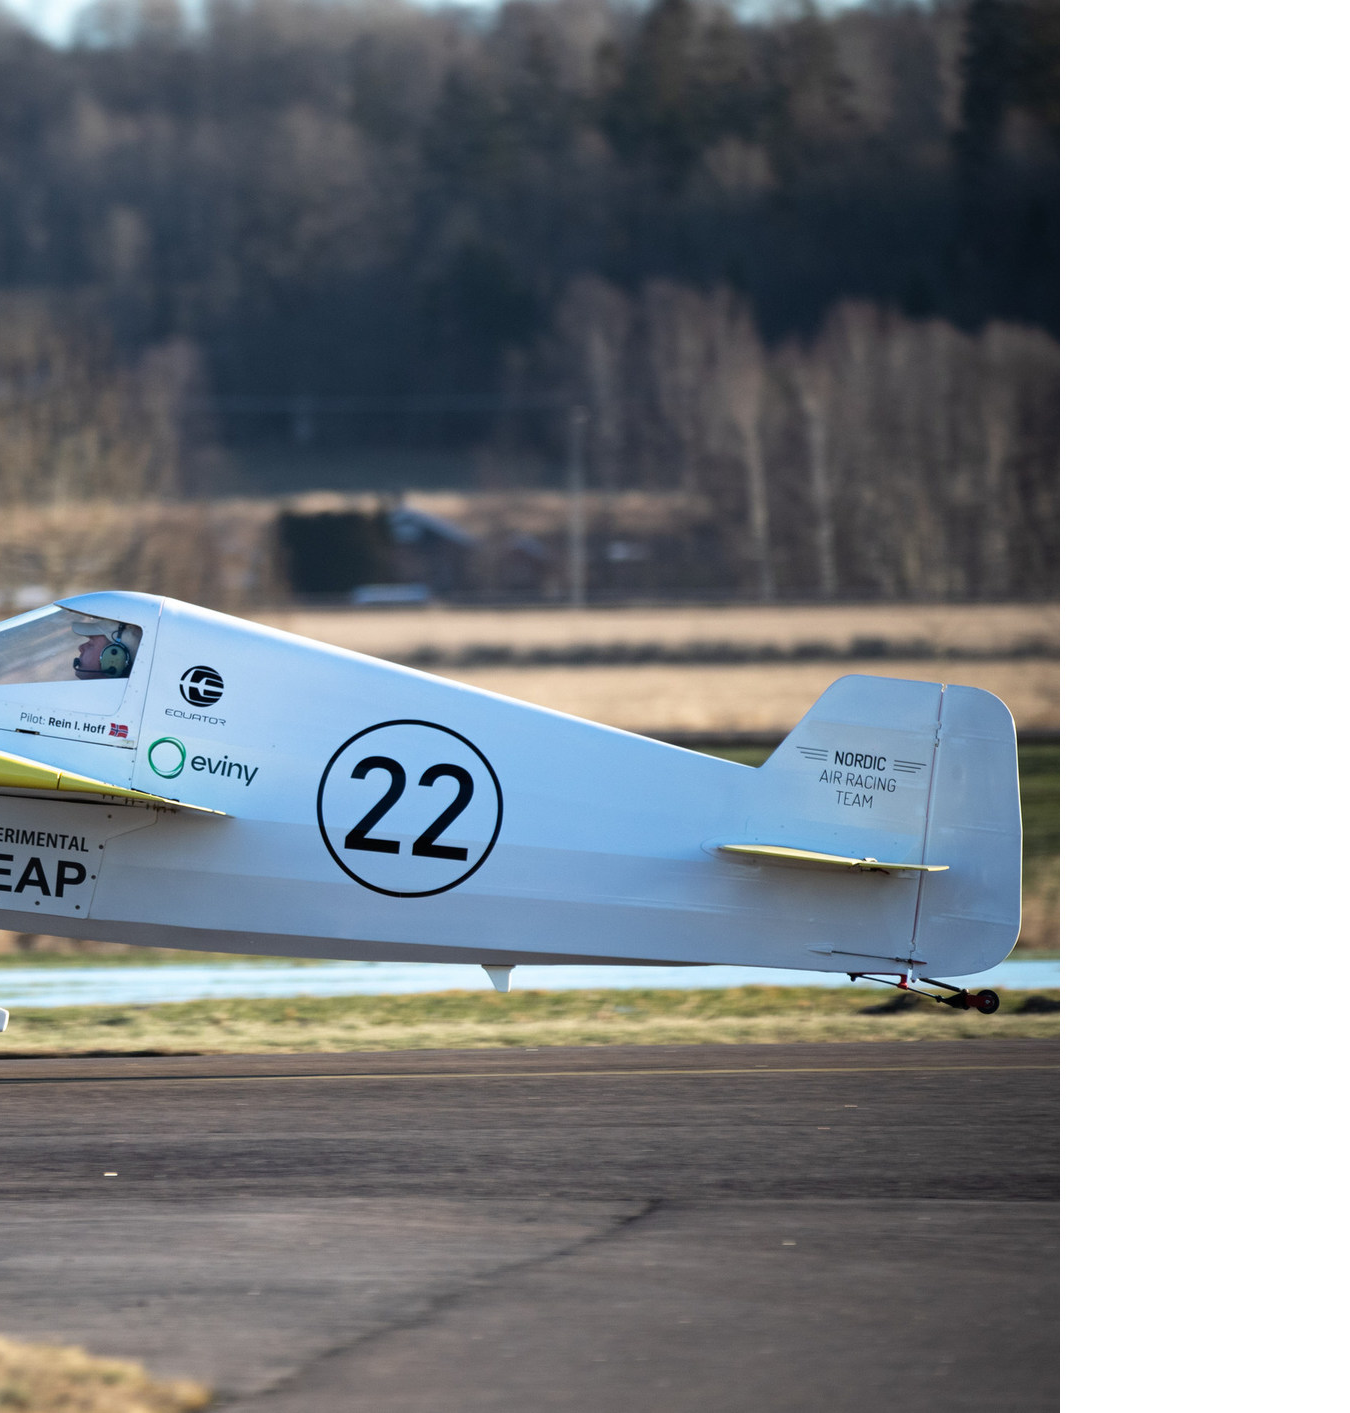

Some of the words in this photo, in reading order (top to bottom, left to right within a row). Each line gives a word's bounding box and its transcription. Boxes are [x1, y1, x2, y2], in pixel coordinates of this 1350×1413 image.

[19, 712, 46, 725] Pilot:
[48, 717, 71, 729] Rein
[74, 721, 81, 731] I.
[83, 723, 107, 735] Hoff
[164, 708, 227, 726] EQUATOR
[190, 755, 259, 787] eviny
[834, 750, 887, 772] NORDIC
[819, 769, 843, 786] AIR
[845, 772, 897, 793] RACING
[344, 755, 475, 862] 22
[836, 790, 873, 809] TEAM
